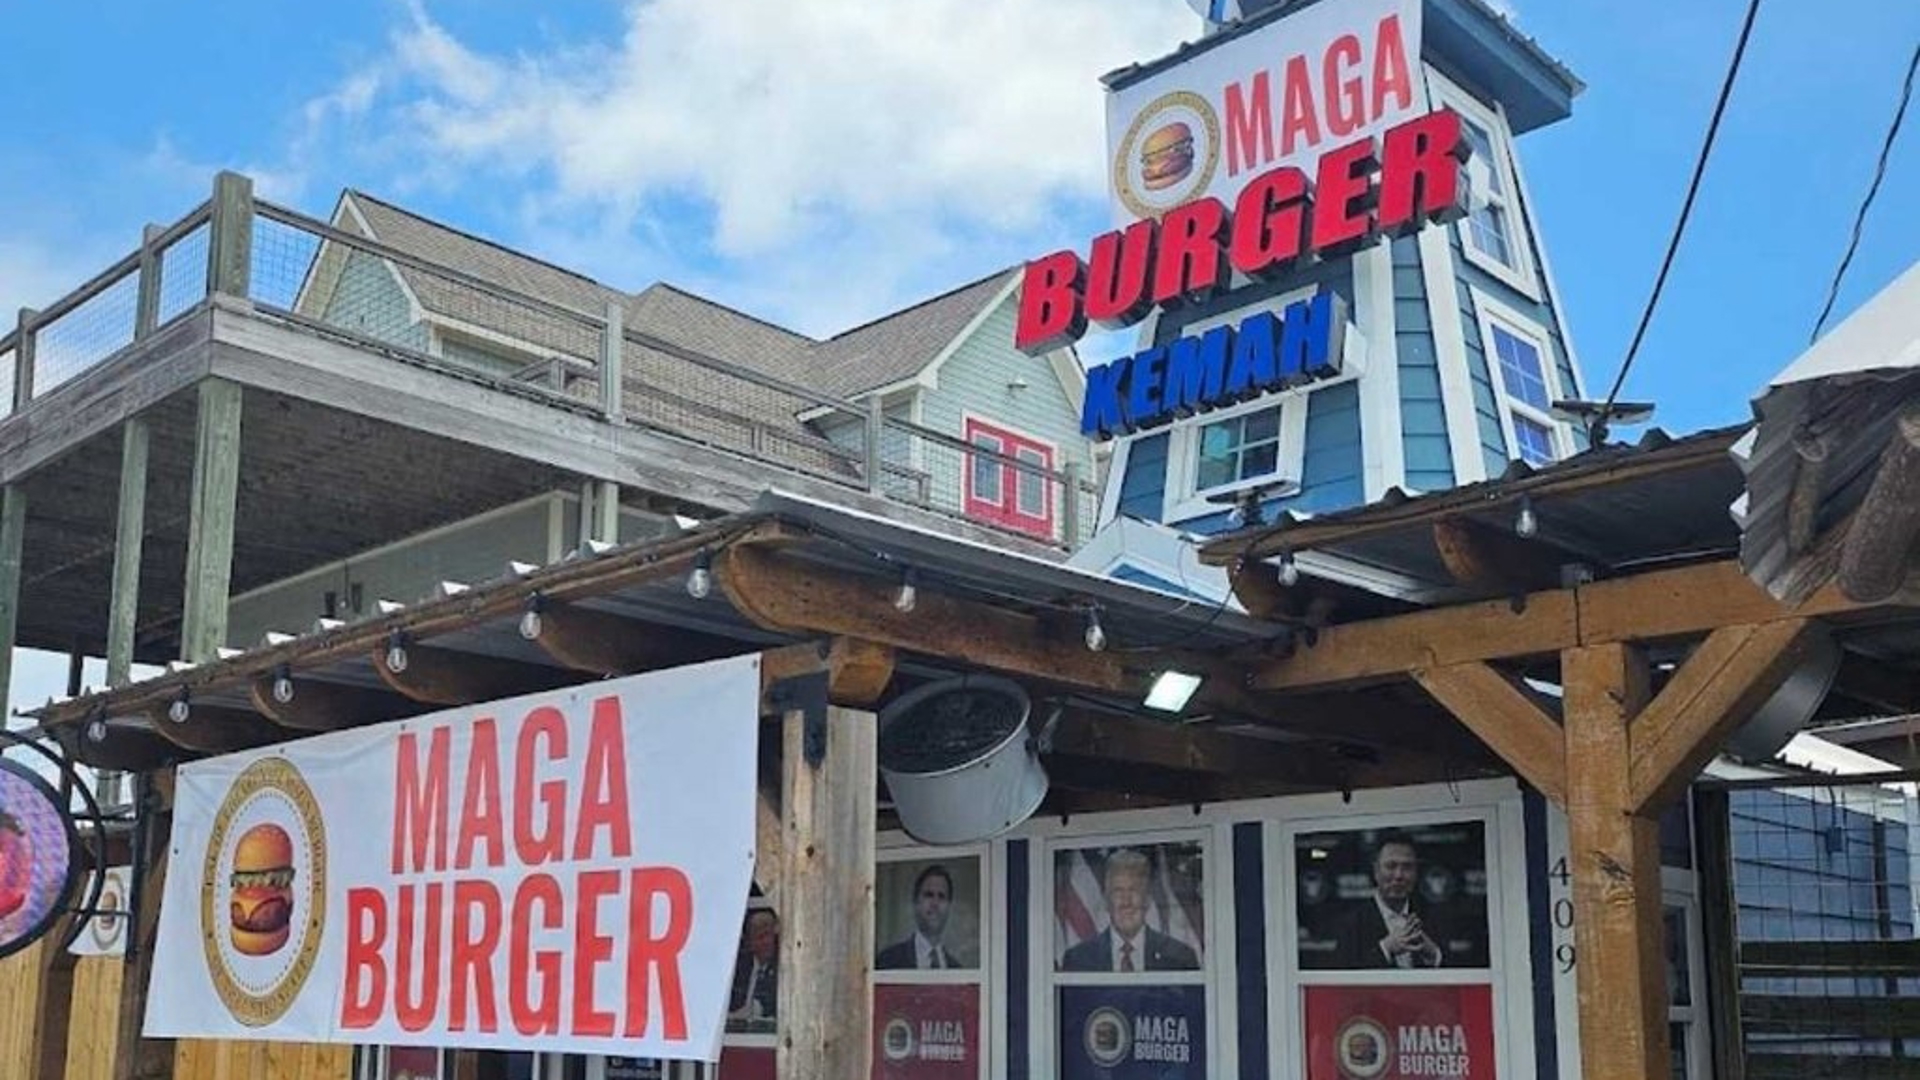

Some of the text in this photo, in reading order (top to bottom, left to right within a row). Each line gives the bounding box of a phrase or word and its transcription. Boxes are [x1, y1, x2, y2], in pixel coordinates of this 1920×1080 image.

[1224, 14, 1412, 177] MAGA
[1015, 108, 1466, 354] BURGER
[1081, 291, 1341, 438] KEMAH
[391, 695, 632, 875] MAGA
[340, 866, 693, 1040] BURGER
[1550, 857, 1577, 973] 409
[920, 1020, 965, 1043] MAGA
[1134, 1042, 1190, 1062] BURGER
[1135, 1016, 1189, 1042] MAGA
[1399, 1024, 1467, 1053] MAGA
[1399, 1054, 1470, 1075] BURGER
